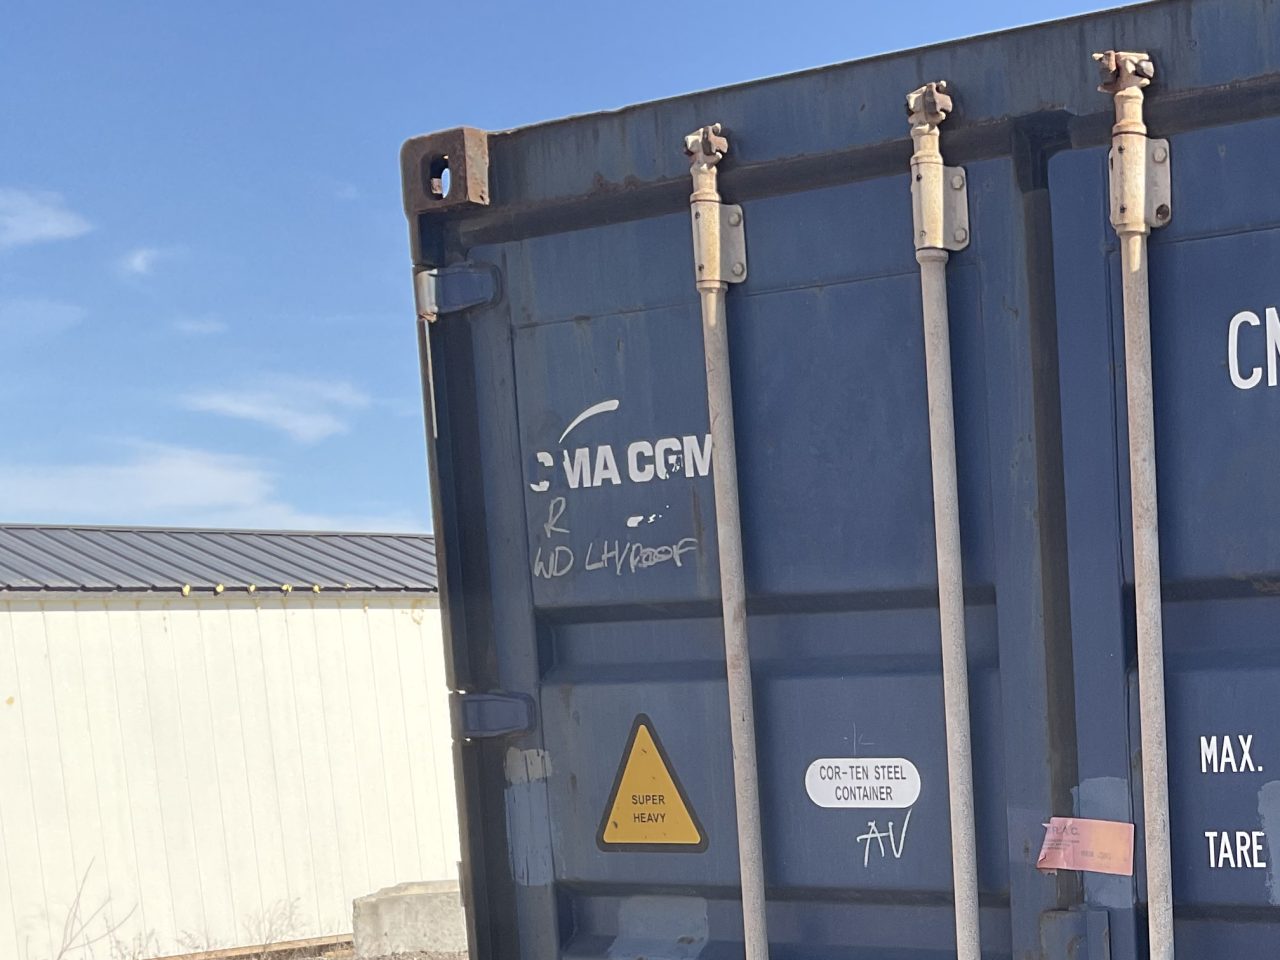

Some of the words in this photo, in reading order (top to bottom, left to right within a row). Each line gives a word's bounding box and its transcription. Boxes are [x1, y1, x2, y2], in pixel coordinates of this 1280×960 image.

[1200, 734, 1264, 774] MAX.
[819, 765, 869, 781] COR-TEN
[874, 765, 907, 780] STEEL
[631, 794, 666, 806] SUPER
[835, 785, 893, 801] CONTAINER
[633, 812, 666, 824] HEAVY
[1204, 831, 1267, 869] TARE
